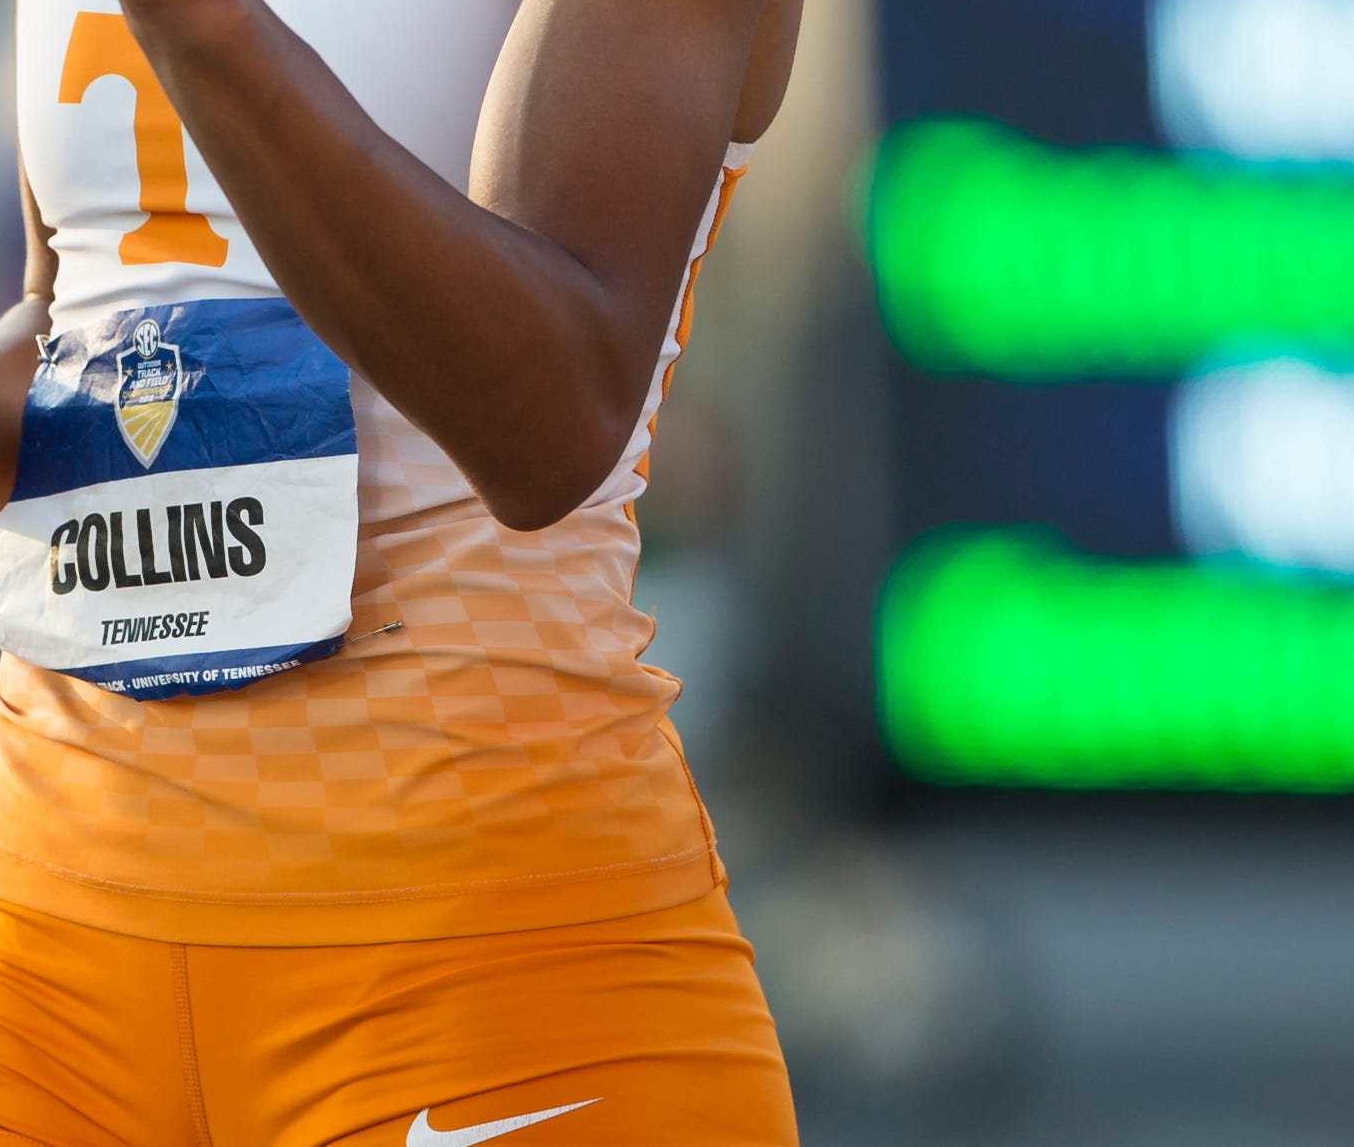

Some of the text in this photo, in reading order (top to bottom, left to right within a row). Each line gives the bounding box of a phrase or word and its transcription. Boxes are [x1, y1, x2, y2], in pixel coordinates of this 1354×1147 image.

[58, 10, 229, 268] T
[135, 323, 157, 356] SEC
[130, 375, 168, 389] AND FIELD
[137, 368, 161, 378] TRACK
[50, 496, 267, 595] COLLINS
[101, 610, 210, 646] TENNESSEE
[131, 670, 200, 690] UNIVERSITY
[202, 669, 220, 682] OF
[222, 658, 302, 680] TENNESSEE
